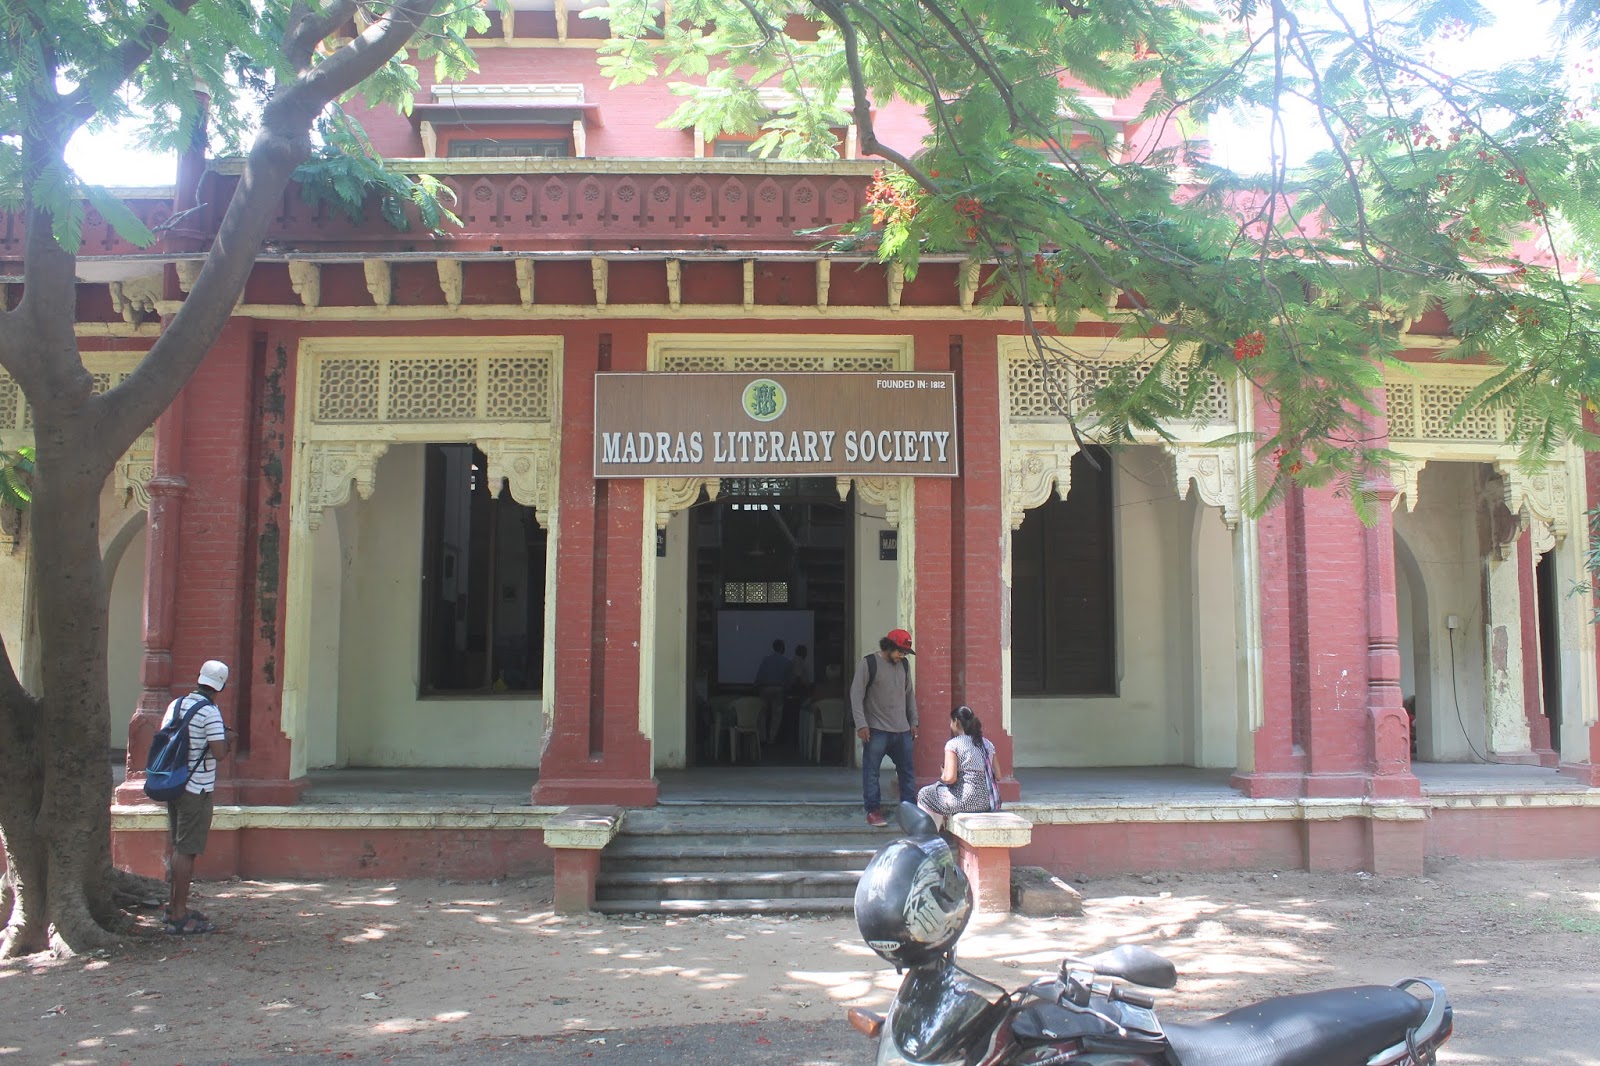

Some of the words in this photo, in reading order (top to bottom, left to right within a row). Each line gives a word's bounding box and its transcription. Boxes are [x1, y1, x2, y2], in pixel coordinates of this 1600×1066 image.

[876, 379, 915, 389] FOUNDED
[917, 380, 928, 389] IN:
[930, 380, 946, 389] 1812
[602, 431, 704, 463] MADRAS
[713, 430, 835, 462] LITERARY
[845, 430, 949, 462] SOCIETY
